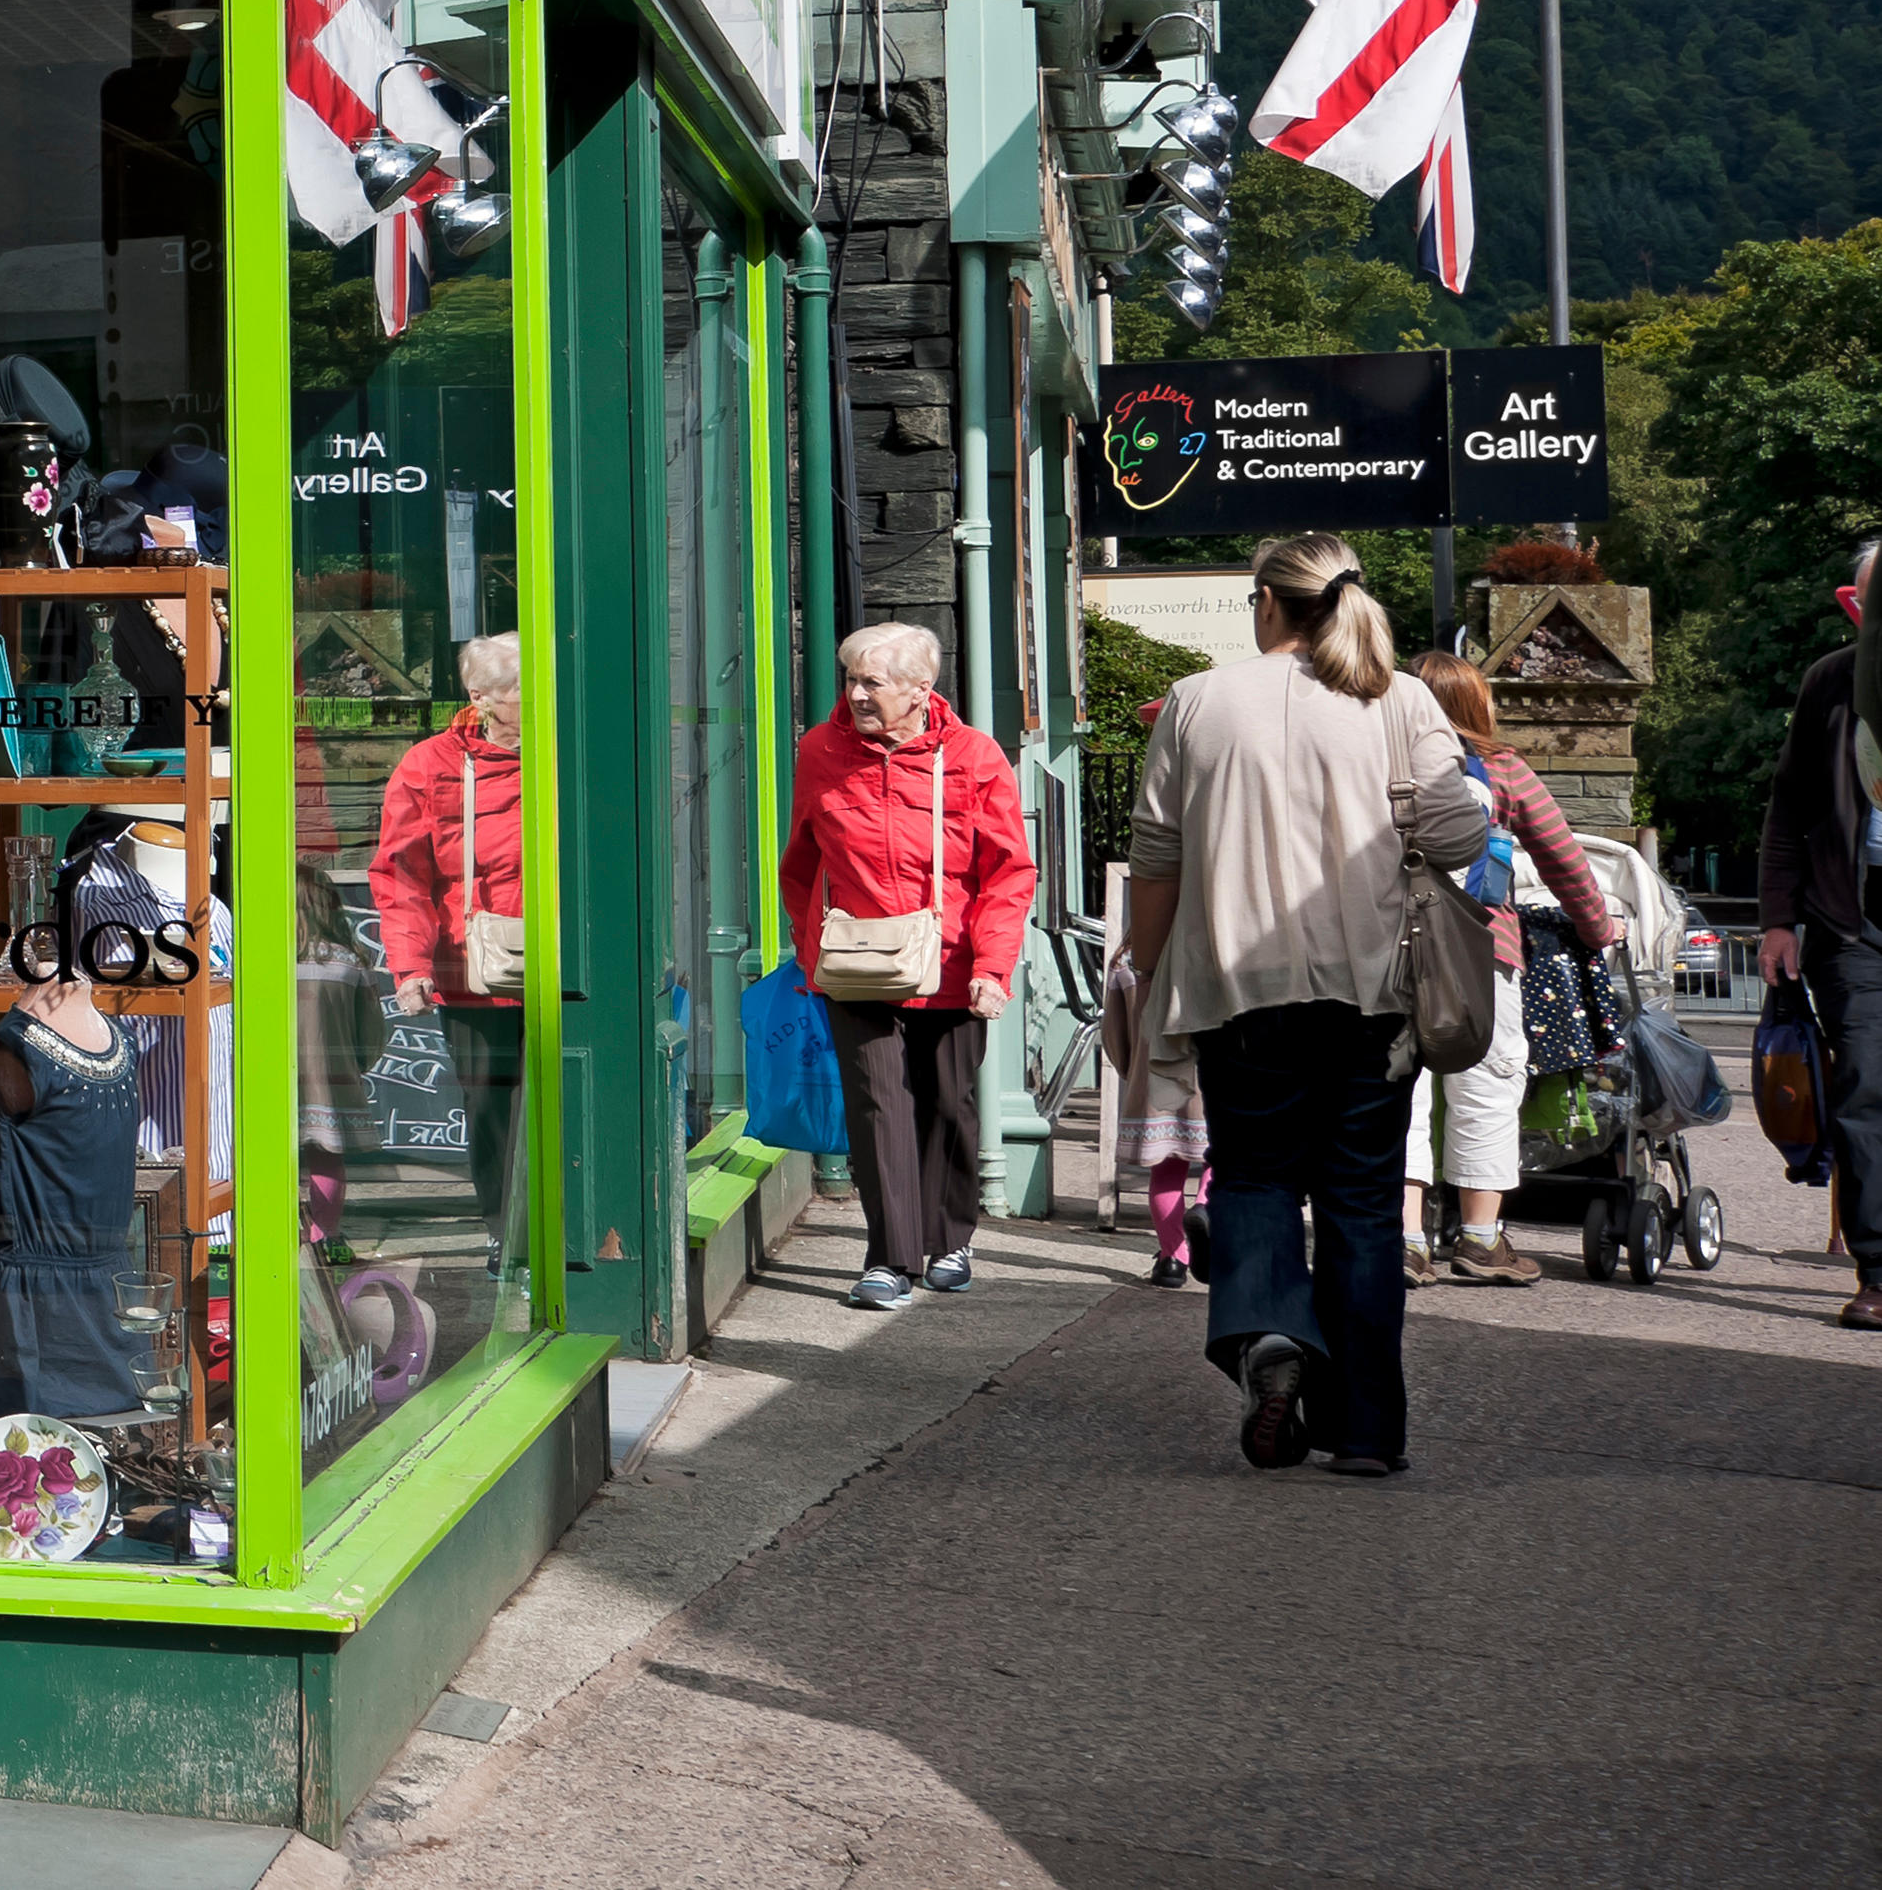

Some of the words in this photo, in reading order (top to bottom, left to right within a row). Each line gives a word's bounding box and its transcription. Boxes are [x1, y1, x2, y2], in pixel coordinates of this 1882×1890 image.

[1114, 383, 1195, 425] Gallery
[1215, 397, 1308, 420] Modern
[1500, 391, 1558, 422] Art
[1179, 432, 1207, 456] 27
[1216, 426, 1341, 450] Traditional
[1464, 429, 1598, 465] Gallery
[1216, 459, 1236, 481] &
[1243, 458, 1425, 482] Contemporary
[1102, 597, 1209, 616] avensworth
[117, 694, 172, 728] IF
